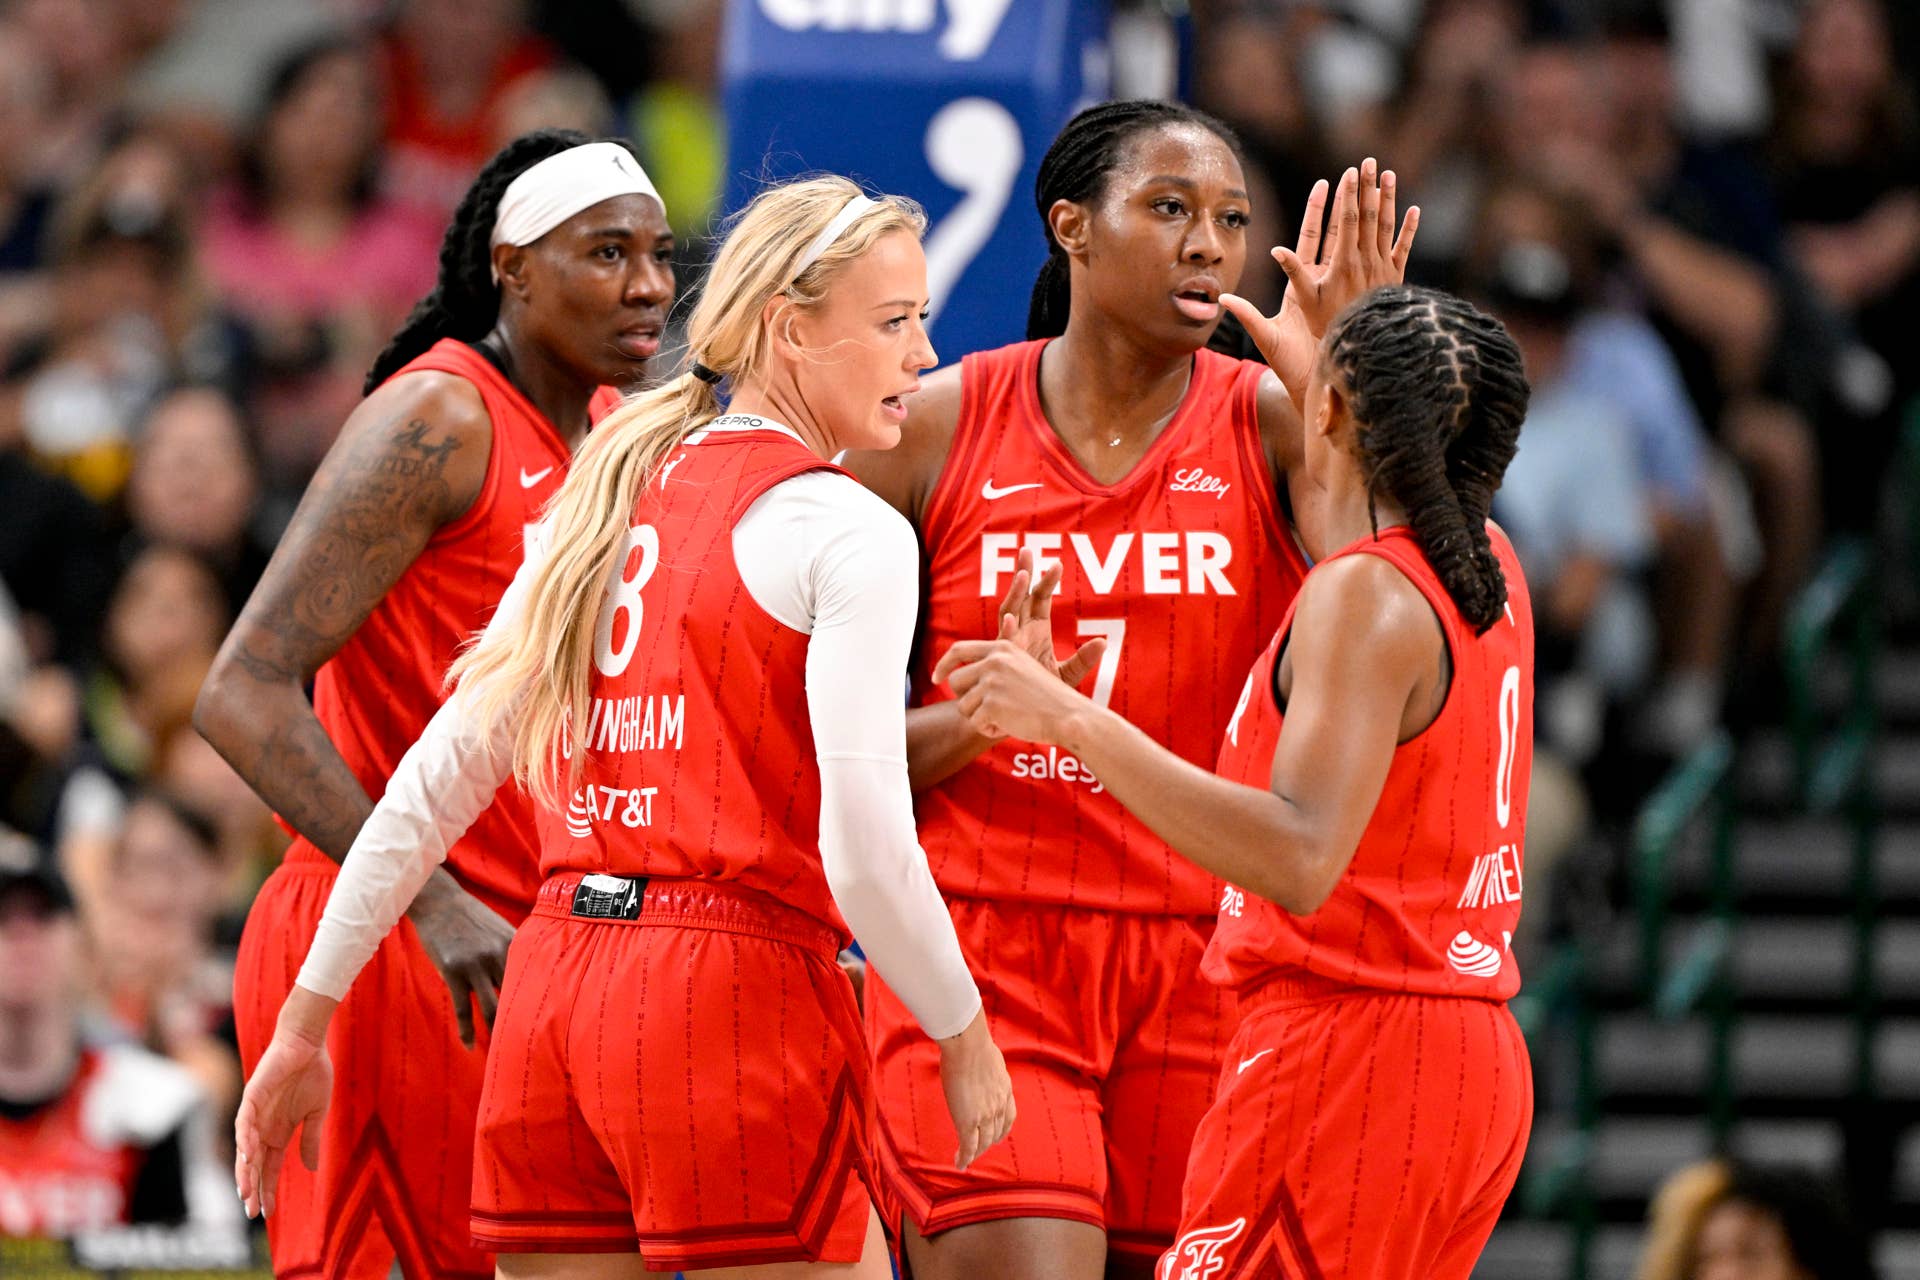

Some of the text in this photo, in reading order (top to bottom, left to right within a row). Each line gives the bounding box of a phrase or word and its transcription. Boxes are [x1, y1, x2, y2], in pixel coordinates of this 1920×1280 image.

[729, 416, 763, 427] PRO
[1169, 467, 1231, 500] Lilly
[980, 531, 1238, 597] FEVER
[594, 524, 659, 677] 8
[1077, 619, 1127, 709] 7
[562, 695, 685, 760] CINGHAM
[1497, 665, 1520, 828] 0
[715, 739, 723, 788] CHOSE
[1010, 745, 1104, 794] sales
[586, 783, 658, 828] AT&T
[713, 794, 721, 814] ME
[639, 957, 649, 1005] CHOSE
[732, 984, 741, 1003] ME
[637, 1012, 645, 1031] ME
[685, 1021, 693, 1060] 2012
[734, 1009, 742, 1106] BASKETBALL
[636, 1038, 645, 1136] BASKETBALL
[686, 1067, 694, 1106] 2020
